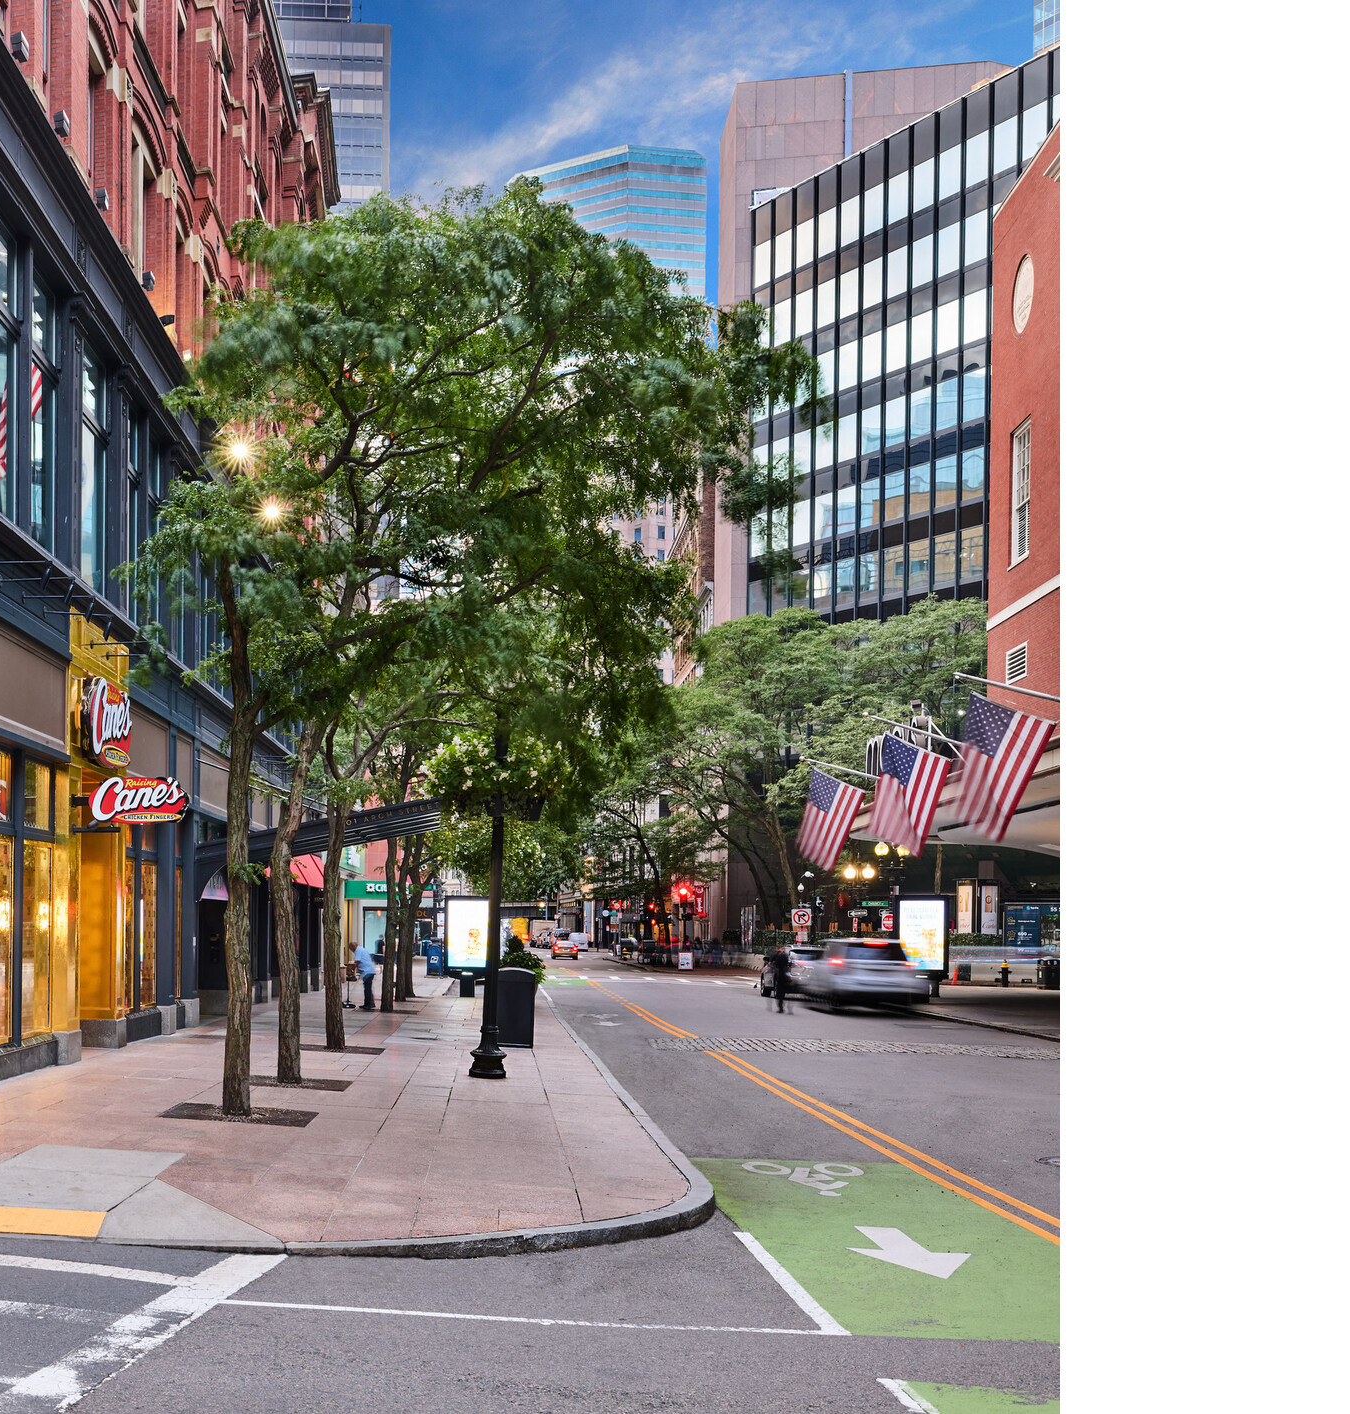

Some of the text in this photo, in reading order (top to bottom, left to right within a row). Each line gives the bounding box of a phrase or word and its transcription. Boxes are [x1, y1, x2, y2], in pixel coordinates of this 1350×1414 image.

[92, 677, 133, 755] Cane's
[92, 776, 185, 821] Cane's
[125, 778, 157, 788] Raising
